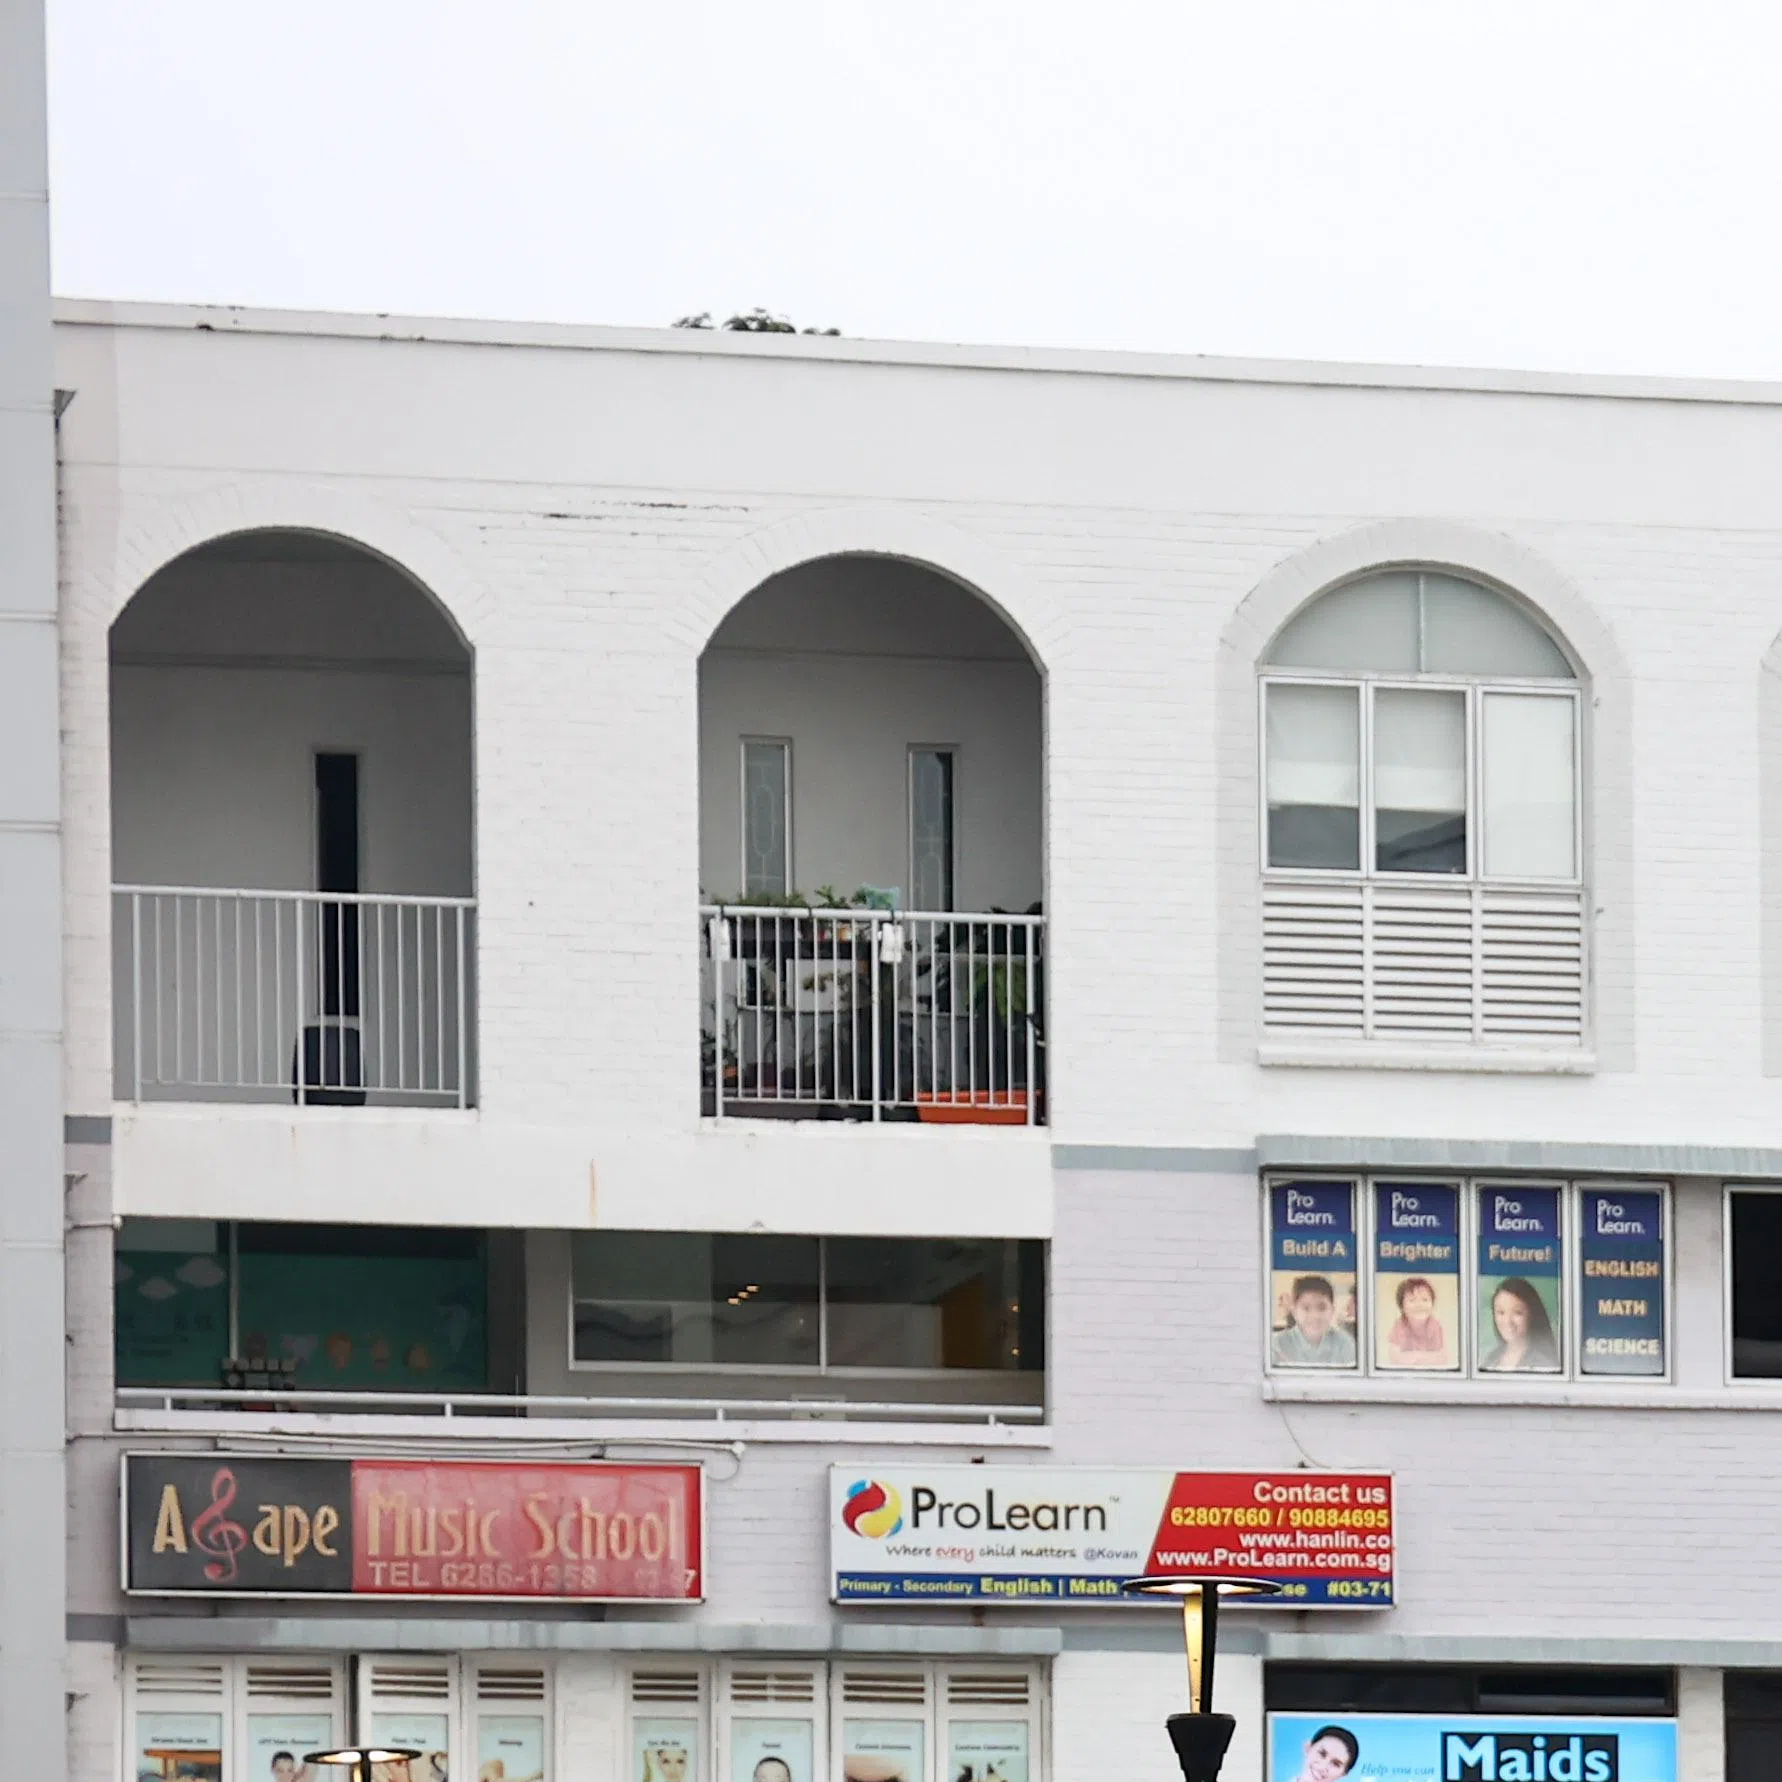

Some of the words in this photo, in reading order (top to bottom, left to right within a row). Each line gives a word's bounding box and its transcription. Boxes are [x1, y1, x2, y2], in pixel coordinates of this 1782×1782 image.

[1287, 1190, 1314, 1209] Pro
[1391, 1191, 1419, 1210] Pro
[1495, 1195, 1521, 1215] Pro
[1597, 1199, 1623, 1218] Pro
[1282, 1239, 1326, 1257] Build
[1331, 1241, 1346, 1257] A
[1380, 1242, 1451, 1262] Brighter
[1489, 1245, 1552, 1263] Future!
[1585, 1260, 1659, 1278] ENGLISH
[1598, 1299, 1647, 1316] MATH
[1586, 1338, 1659, 1356] SCIENCE
[1254, 1482, 1349, 1503] Contact
[1357, 1486, 1386, 1503] us
[912, 1487, 1106, 1531] ProLearn
[1171, 1507, 1271, 1527] 62807660
[1277, 1508, 1284, 1526] /
[1289, 1508, 1389, 1528] 90884695
[367, 1490, 501, 1558] Music
[533, 1491, 678, 1562] School
[886, 1545, 932, 1557] Where
[935, 1546, 974, 1562] every
[979, 1545, 1016, 1557] child
[1021, 1547, 1076, 1558] matters
[1157, 1548, 1391, 1572] www.ProLearn.com.sg
[368, 1561, 430, 1586] TEL
[839, 1579, 891, 1593] Primary
[903, 1579, 973, 1594] Secondary
[980, 1577, 1053, 1596] English
[1069, 1580, 1118, 1594] Math
[1327, 1581, 1391, 1597] #03-71
